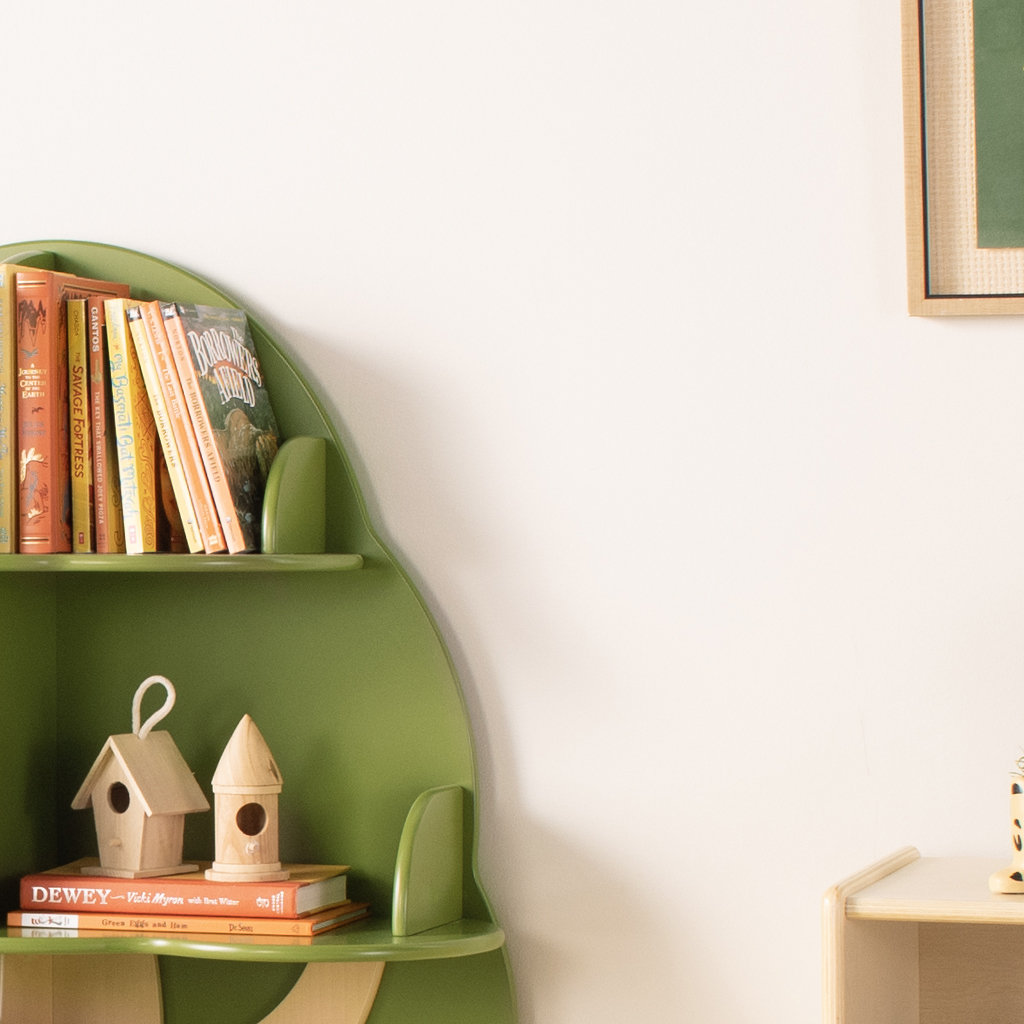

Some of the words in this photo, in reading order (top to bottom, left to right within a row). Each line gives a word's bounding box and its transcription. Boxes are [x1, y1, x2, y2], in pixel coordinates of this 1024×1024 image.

[91, 306, 100, 352] GANTOS
[110, 353, 123, 372] My
[187, 328, 262, 387] BORROWERS
[22, 391, 46, 399] EARTH
[72, 364, 85, 415] SAVAGE
[112, 375, 133, 431] Basmati
[213, 366, 256, 408] AFIELD
[190, 391, 210, 448] BORROWERS
[73, 418, 85, 478] FORTRESS
[117, 434, 135, 460] Bat
[32, 886, 111, 905] DEWEY
[127, 891, 152, 904] Vicki
[151, 893, 184, 906] Myron
[102, 918, 126, 927] Green
[130, 919, 149, 928] Eggs
